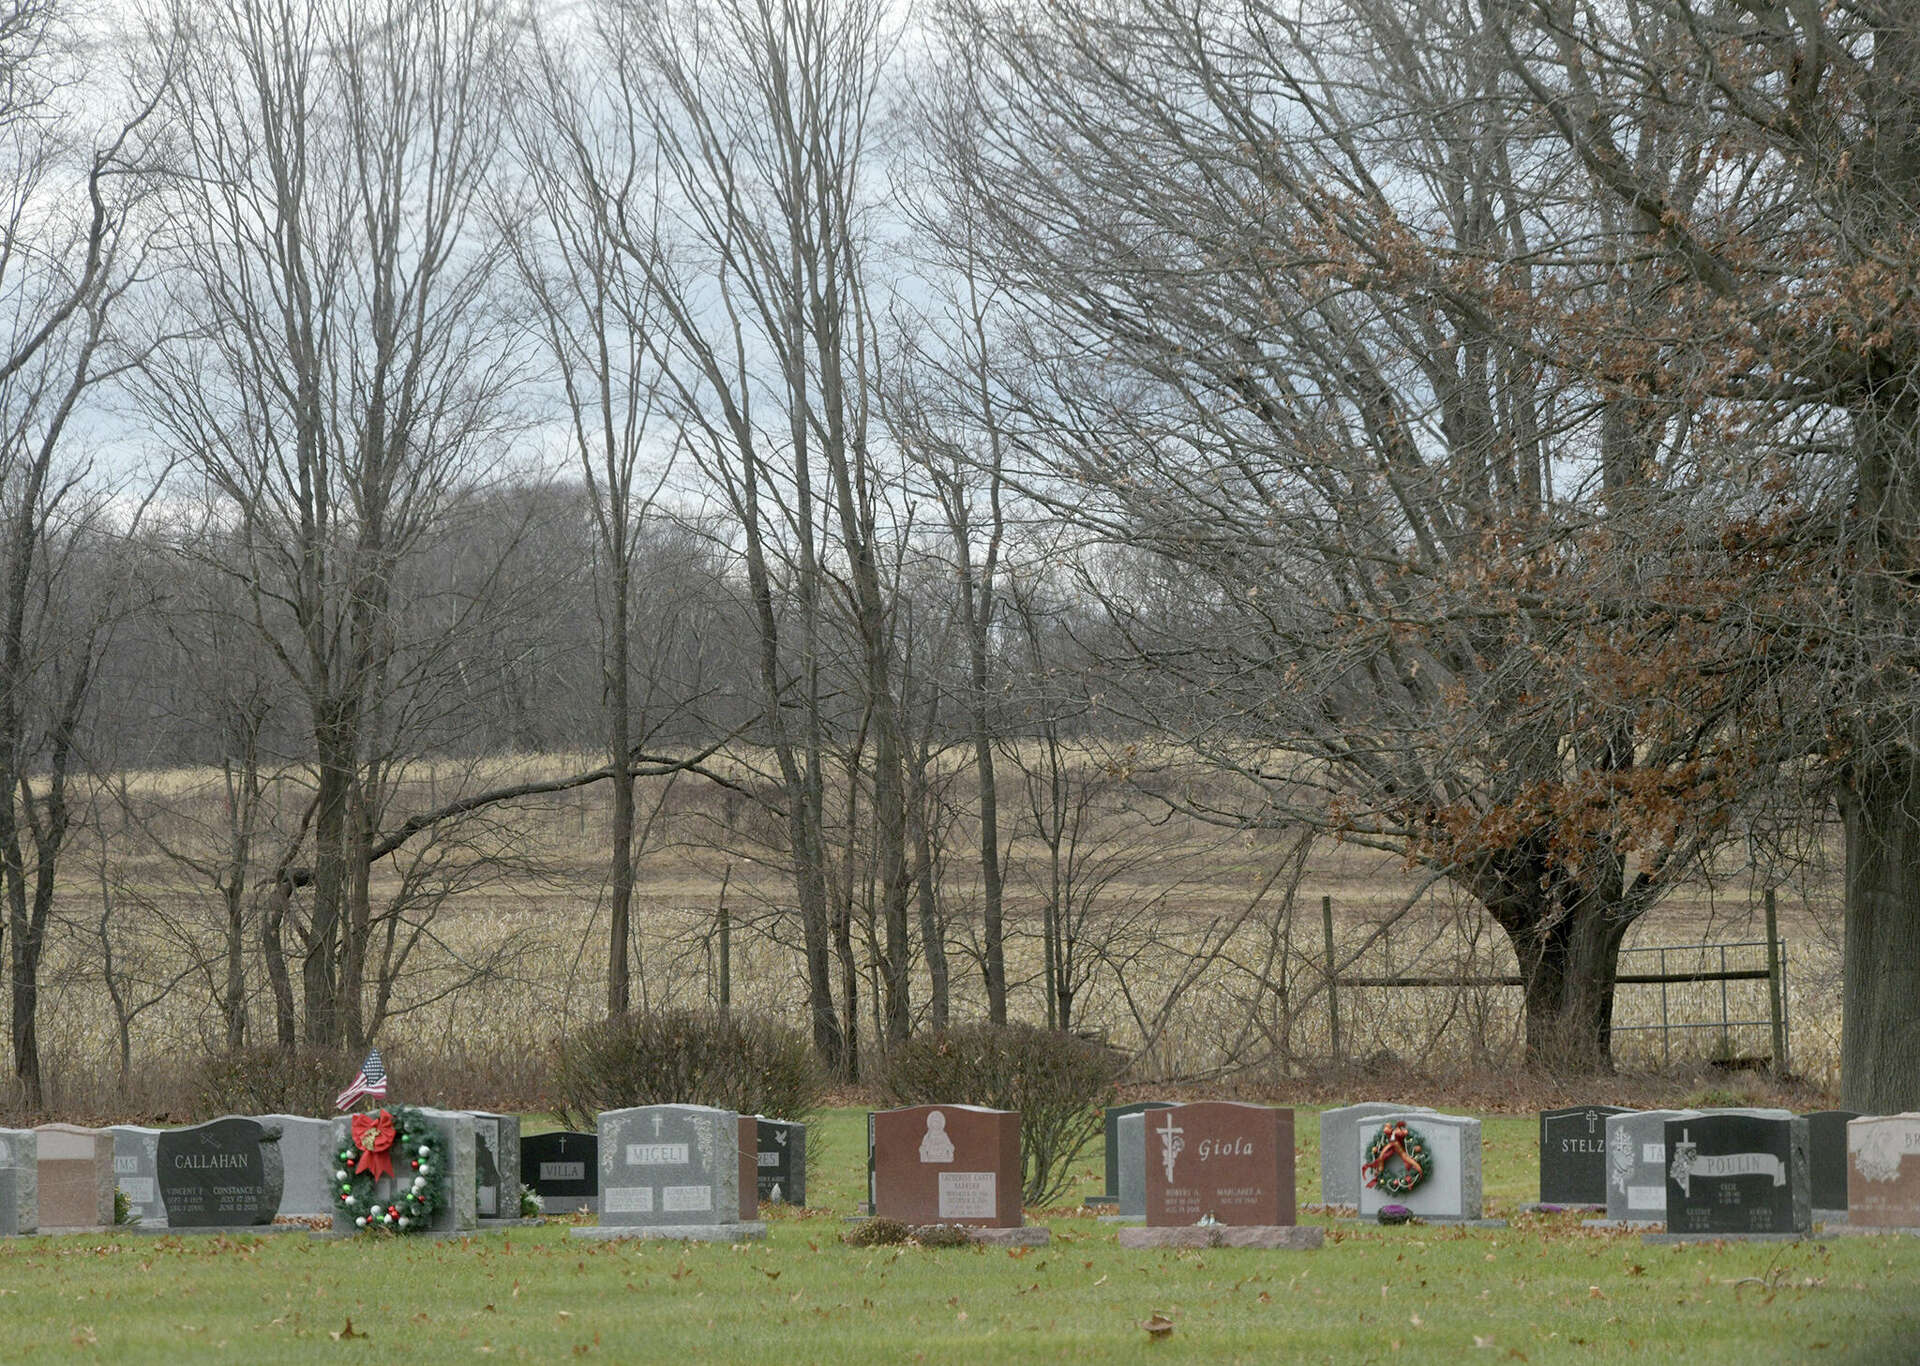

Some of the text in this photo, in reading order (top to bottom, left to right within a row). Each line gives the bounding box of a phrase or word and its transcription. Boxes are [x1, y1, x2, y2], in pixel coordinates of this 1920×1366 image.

[1199, 1136, 1254, 1161] Giola
[1562, 1139, 1605, 1153] STELZ
[175, 1154, 248, 1168] CALLAHAN
[1706, 1155, 1761, 1174] POULIN
[545, 1164, 578, 1177] VILLA
